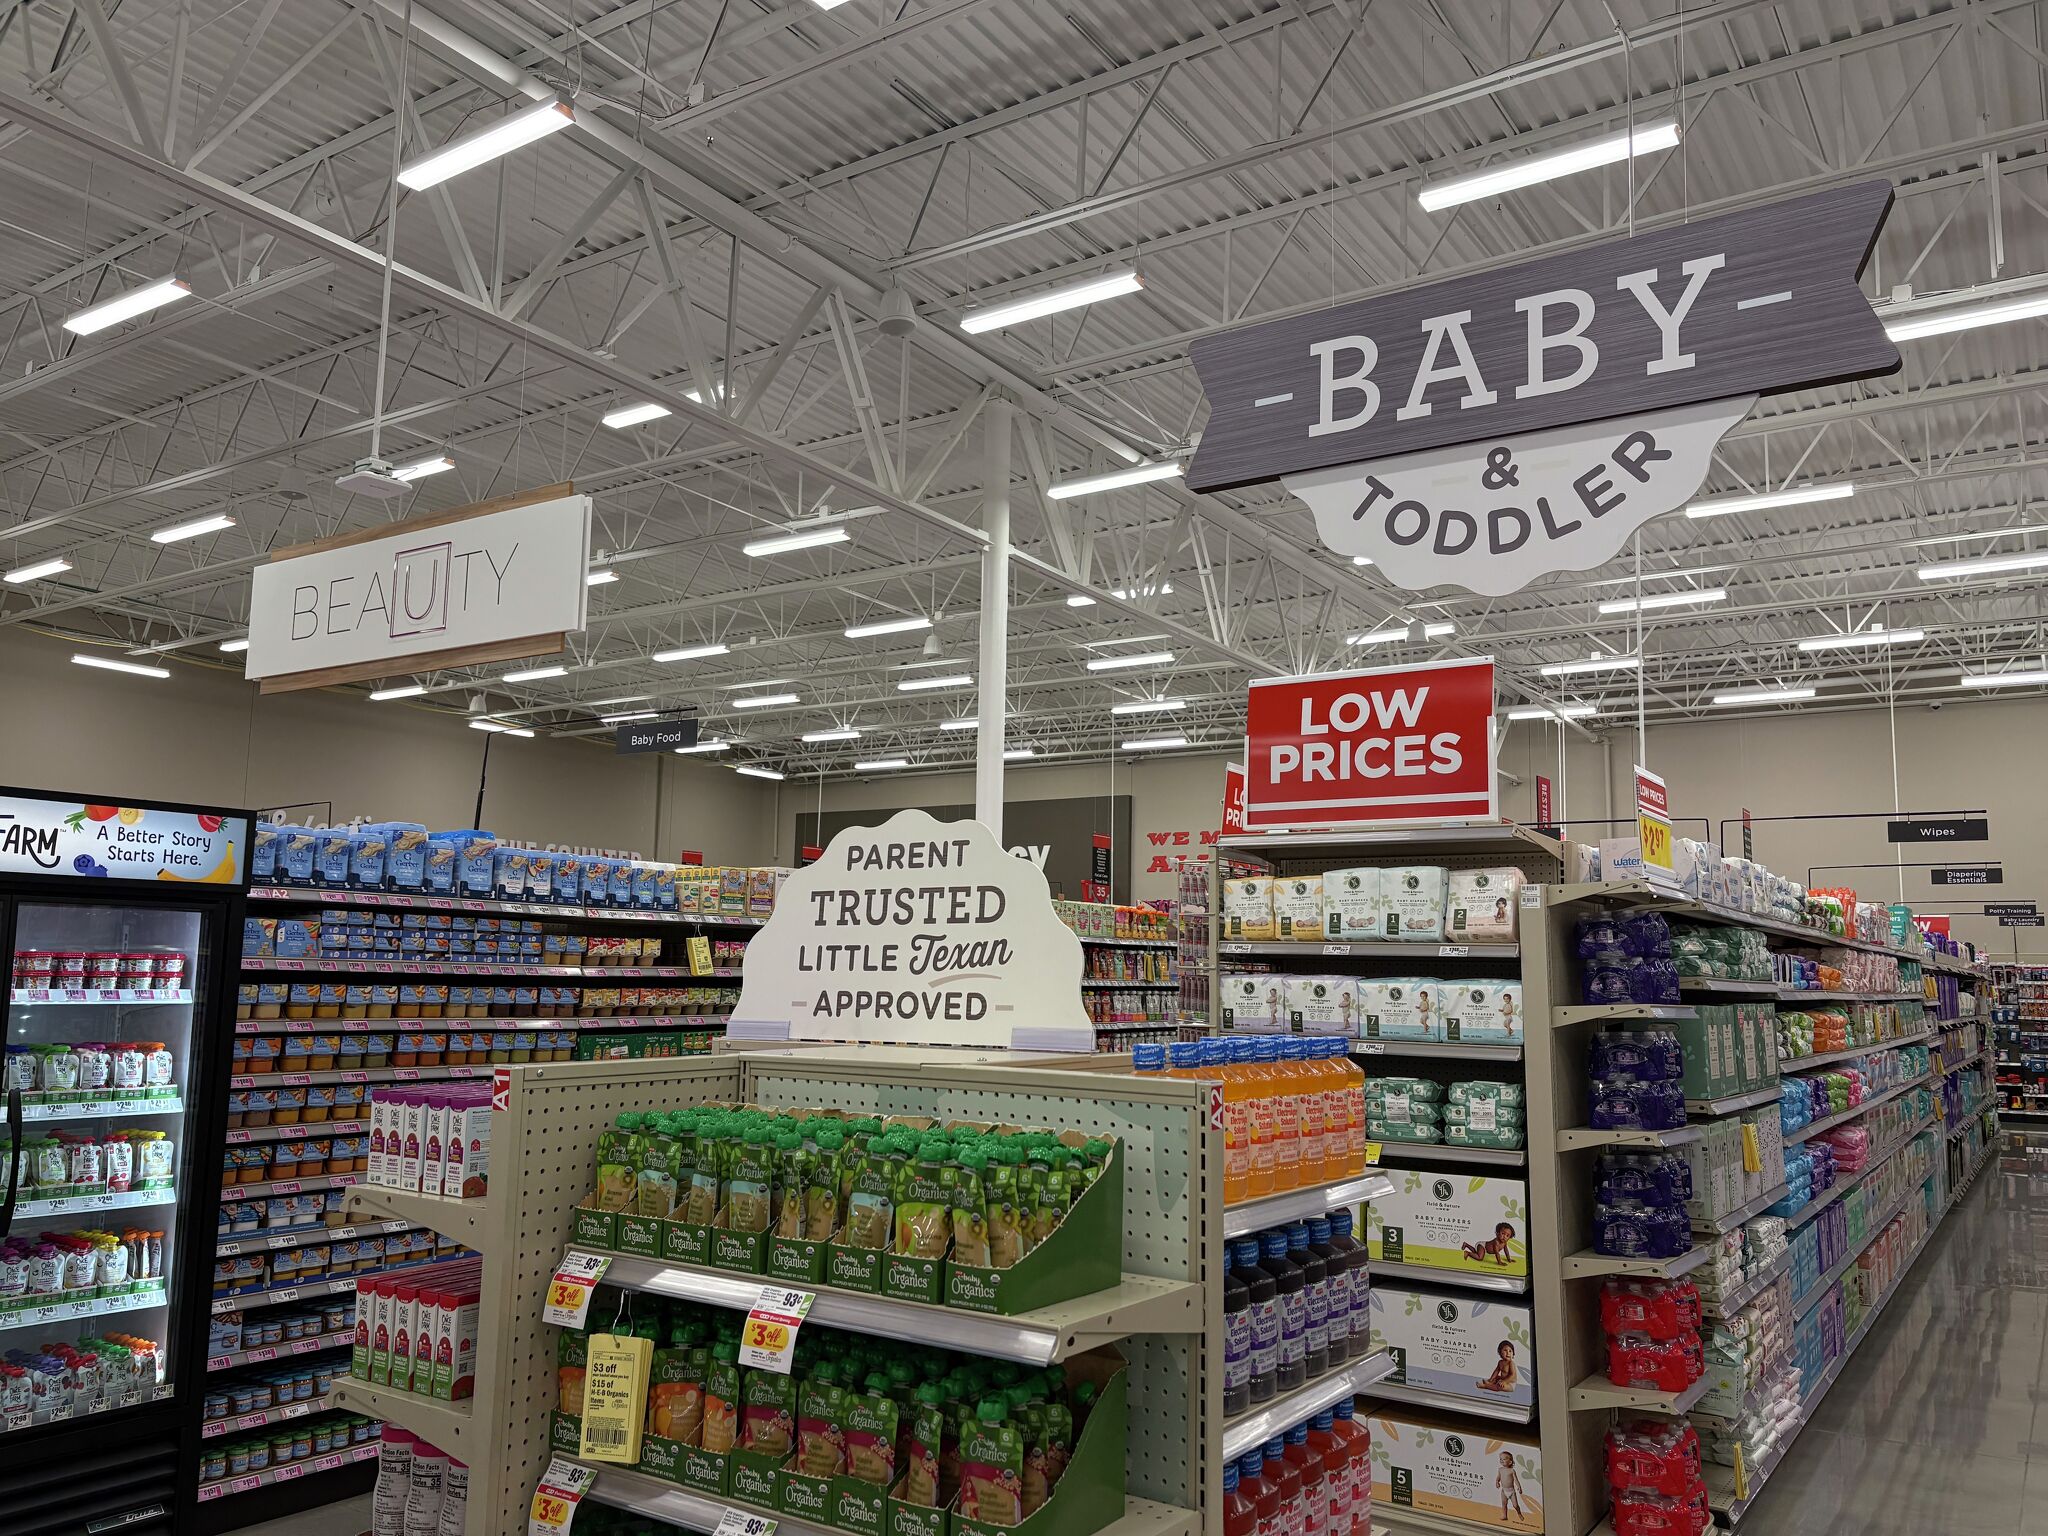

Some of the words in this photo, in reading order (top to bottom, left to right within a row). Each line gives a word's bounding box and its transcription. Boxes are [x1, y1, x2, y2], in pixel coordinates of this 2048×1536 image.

[1308, 253, 1726, 438] BABY
[1481, 446, 1519, 490] &
[1350, 429, 1673, 556] TODDLER
[292, 542, 519, 641] BEAUTY
[1300, 686, 1430, 736] LOW
[631, 734, 655, 748] Baby
[656, 730, 682, 745] Food
[1270, 732, 1463, 785] PRICES
[1639, 785, 1650, 798] LOW
[1650, 788, 1665, 806] PRICES
[97, 826, 108, 840] A
[117, 827, 164, 845] Better
[172, 831, 211, 852] Story
[1147, 831, 1190, 846] WE
[1919, 827, 1956, 837] Wipes
[0, 824, 61, 868] ARM
[108, 846, 155, 862] Starts
[163, 849, 202, 866] Here.
[847, 838, 970, 872] PARENT
[1097, 886, 1105, 897] 35
[810, 885, 1006, 927] TRUSTED
[1457, 911, 1464, 919] 2
[799, 944, 899, 972] LITTLE
[909, 933, 1013, 976] Texan
[812, 990, 988, 1021] APPROVED
[492, 1075, 510, 1111] A1
[1211, 1087, 1223, 1129] A2
[1415, 1214, 1436, 1222] BABY
[1438, 1216, 1471, 1225] DIAPERS
[578, 1221, 607, 1239] Organics
[622, 1227, 653, 1246] Organics
[1388, 1229, 1398, 1242] 3
[668, 1233, 701, 1253] Organics
[717, 1241, 751, 1261] Organics
[584, 1257, 601, 1270] 93¢
[773, 1251, 810, 1272] Organics
[833, 1260, 871, 1281] Organics
[888, 1268, 929, 1290] Organics
[951, 1277, 996, 1300] Organics
[566, 1289, 580, 1302] off
[783, 1293, 803, 1307] 93¢
[767, 1327, 782, 1342] off
[1421, 1336, 1440, 1344] BABY
[1444, 1340, 1477, 1349] DIAPERS
[1390, 1349, 1400, 1363] 4
[593, 1362, 604, 1373] $3
[605, 1364, 617, 1374] off
[592, 1380, 606, 1388] $15
[607, 1380, 613, 1389] of
[607, 1390, 629, 1398] Organics
[642, 1448, 675, 1468] Organics
[969, 1443, 1009, 1463] Organics
[568, 1468, 586, 1483] 93¢
[686, 1462, 720, 1481] Organics
[1396, 1470, 1406, 1485] 5
[1425, 1465, 1445, 1473] BABY
[1450, 1470, 1484, 1480] DIAPERS
[735, 1475, 771, 1495] Organics
[786, 1488, 824, 1509] Organics
[550, 1503, 563, 1517] off
[839, 1502, 878, 1522] Organics
